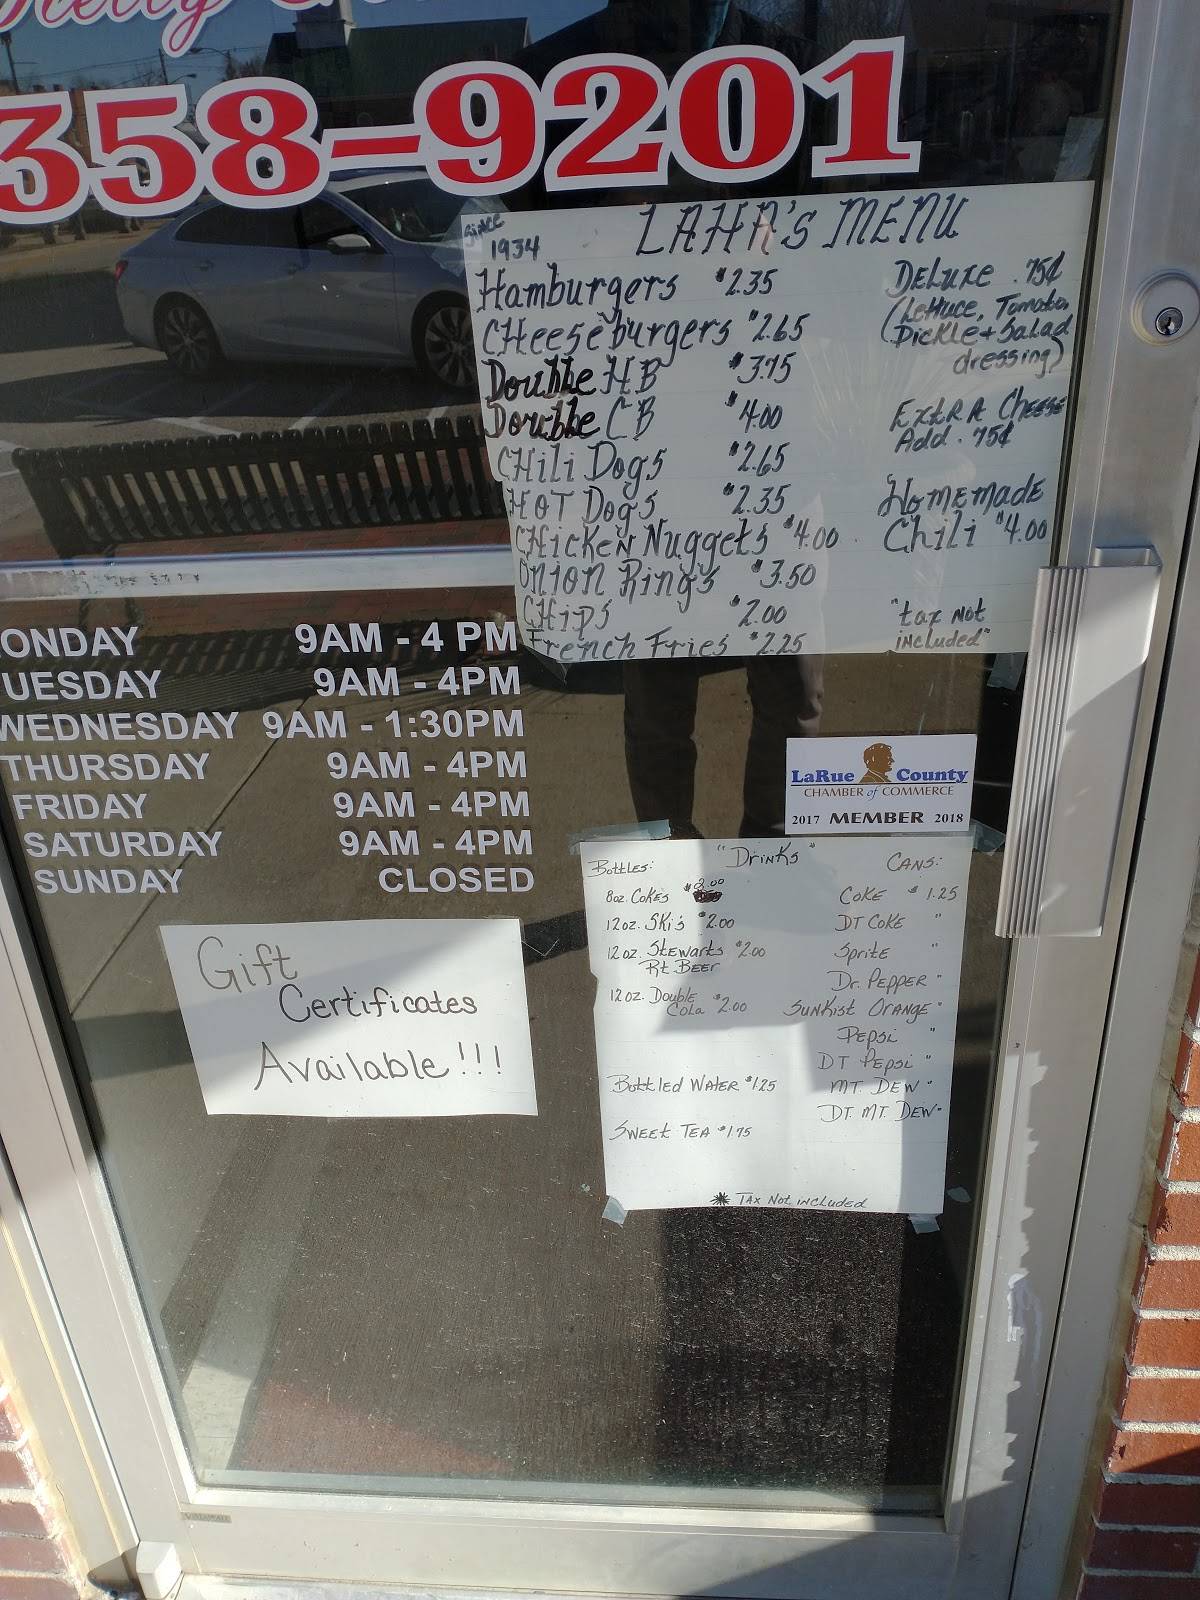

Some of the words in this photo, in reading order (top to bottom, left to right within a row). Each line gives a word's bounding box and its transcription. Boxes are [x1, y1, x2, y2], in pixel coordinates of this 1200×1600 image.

[822, 193, 968, 249] MENU
[491, 235, 541, 261] 1934
[475, 262, 679, 313] Hamburgers
[894, 424, 952, 453] Add
[584, 440, 668, 500] Dogs
[581, 484, 659, 538] Dogs
[642, 518, 770, 577] Nuggets
[617, 557, 721, 614] Rings
[294, 622, 383, 654] 9AM
[396, 637, 410, 646] -
[421, 621, 444, 652] 4
[456, 621, 518, 652] PM
[524, 629, 637, 660] French
[644, 626, 731, 658] Fries
[313, 667, 400, 697] 9AM
[413, 681, 427, 689] -
[437, 666, 521, 696] 4PM
[0, 711, 239, 742] WEDNESDAY
[262, 710, 347, 739] 9AM
[360, 724, 373, 732] -
[385, 709, 524, 738] 1:30PM
[0, 752, 210, 782] THURSDAY
[326, 751, 411, 779] 9AM
[446, 751, 527, 778] 4PM
[791, 769, 855, 783] LaRue
[896, 768, 969, 783] County
[11, 793, 147, 820] FRIDAY
[333, 791, 415, 818] 9AM
[450, 791, 530, 817] 4PM
[804, 788, 864, 798] CHAMBER
[866, 786, 880, 801] of
[882, 786, 955, 797] COMMERCE
[791, 815, 820, 825] 2017
[829, 811, 924, 825] MEMBER
[934, 813, 964, 823] 2018
[23, 831, 223, 858] SATURDAY
[338, 830, 420, 856] 9AM
[454, 829, 533, 855] 4PM
[33, 869, 183, 894] SUNDAY
[378, 867, 535, 893] CLOSED
[197, 935, 298, 993] Gift
[278, 983, 478, 1023] Certificates
